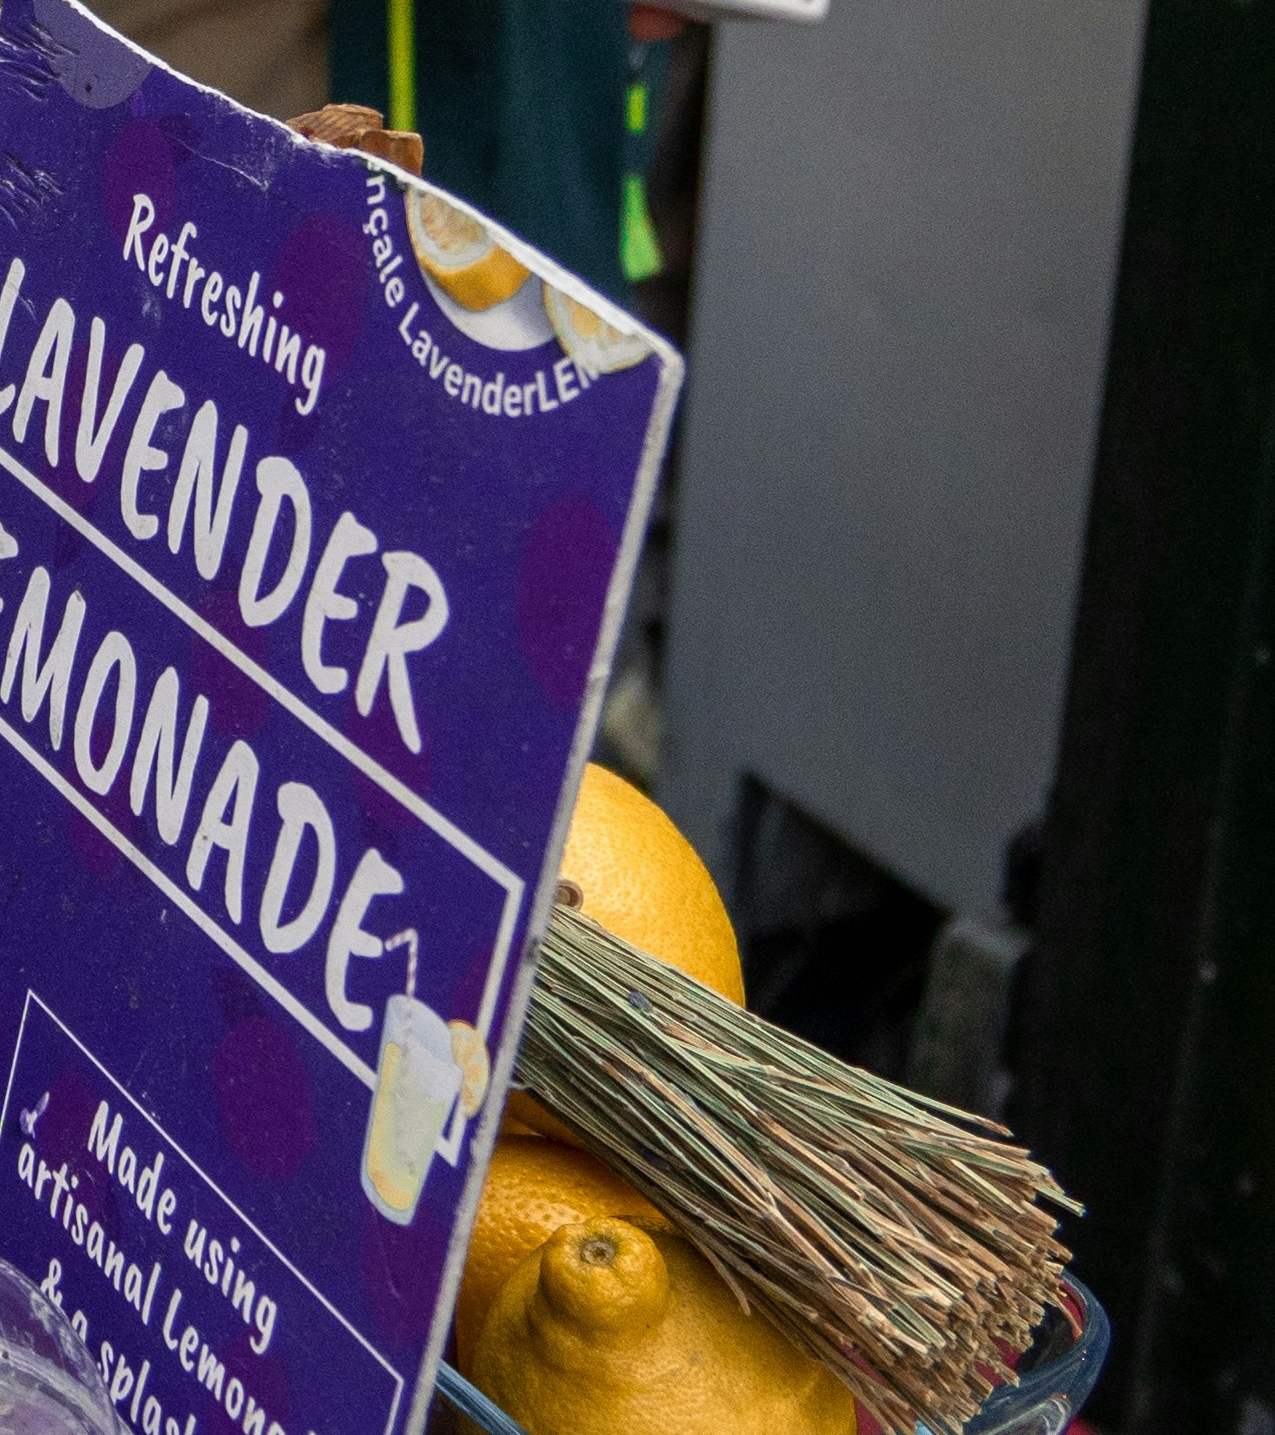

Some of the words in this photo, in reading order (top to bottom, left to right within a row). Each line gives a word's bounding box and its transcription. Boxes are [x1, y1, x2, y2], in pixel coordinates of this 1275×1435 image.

[122, 192, 327, 417] Refreshing
[361, 158, 407, 310] nçale
[17, 1141, 164, 1328] artisanal
[39, 1257, 64, 1308] &
[71, 1308, 89, 1344] a
[86, 1098, 178, 1236] Made
[183, 1217, 280, 1357] using
